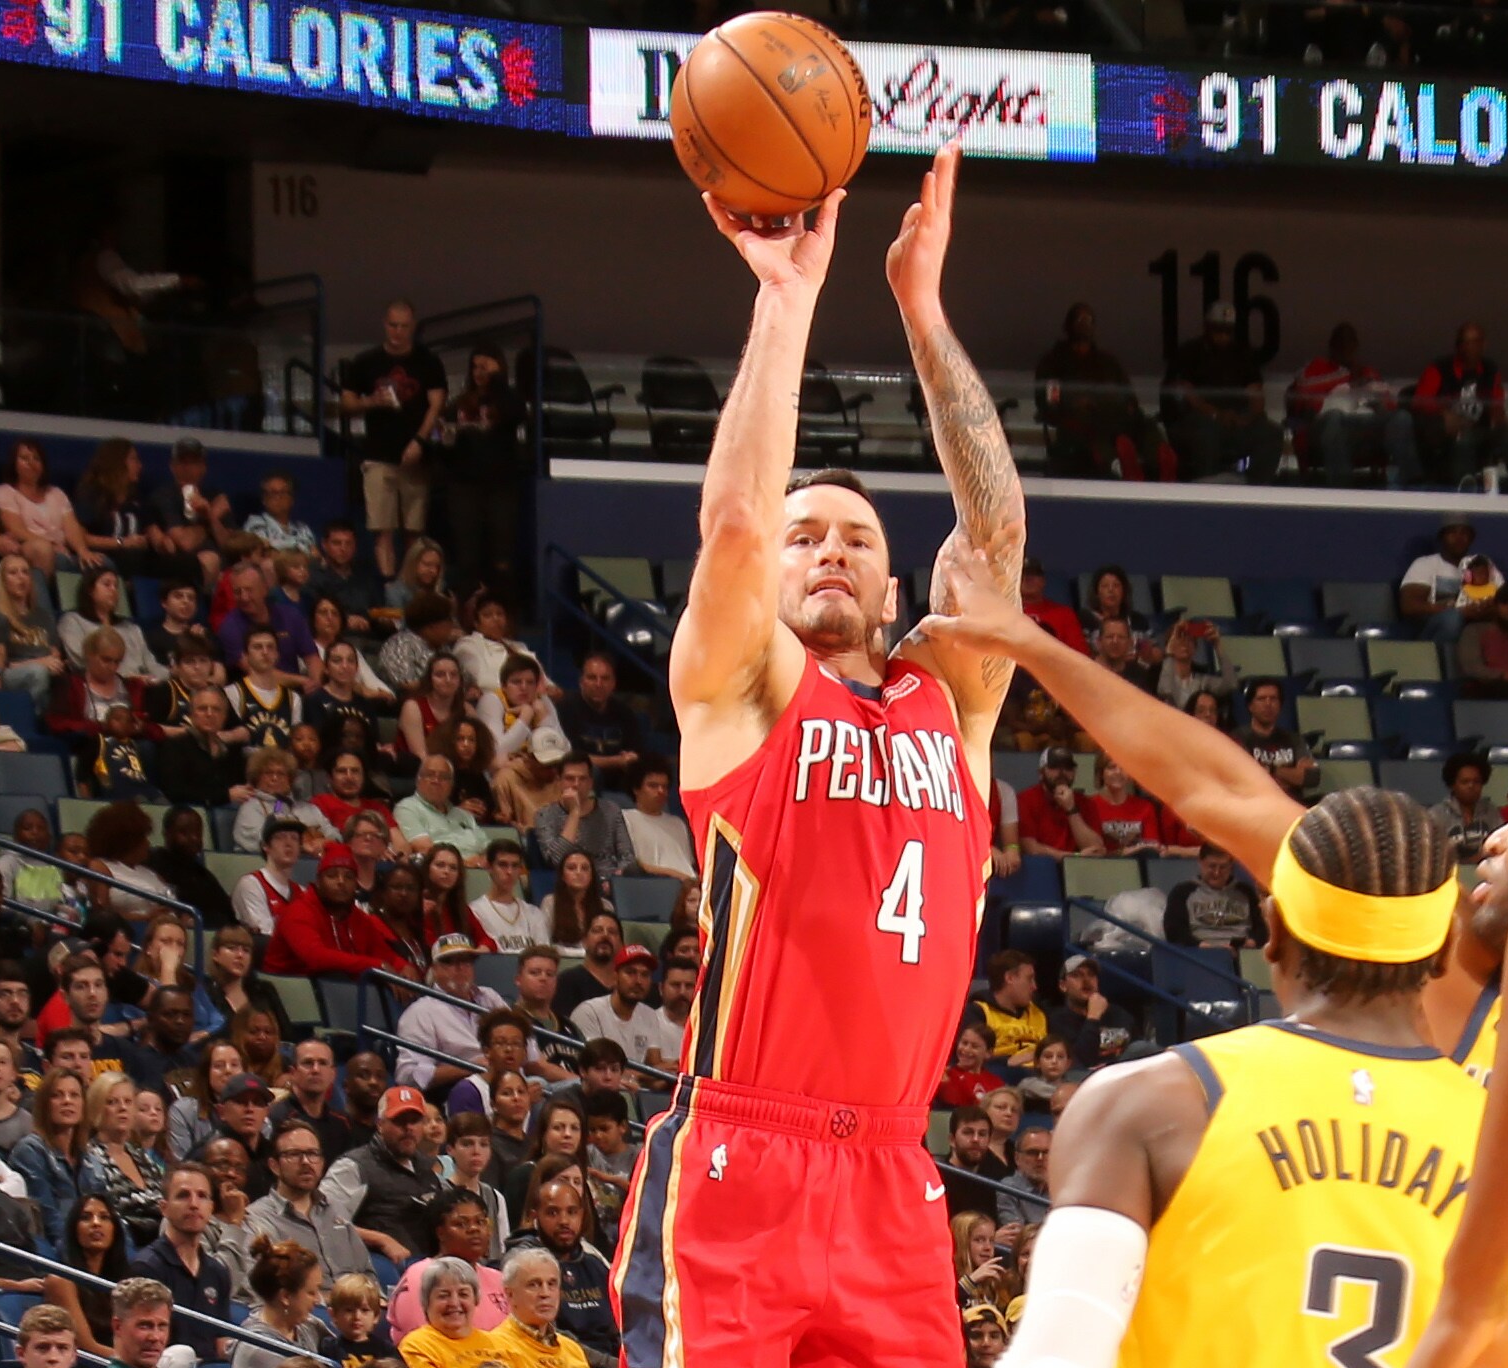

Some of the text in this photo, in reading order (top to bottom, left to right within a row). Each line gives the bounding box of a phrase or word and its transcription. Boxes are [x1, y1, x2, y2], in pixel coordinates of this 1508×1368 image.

[43, 0, 499, 110] 91 CALORIES
[1198, 71, 1277, 155] 91
[268, 174, 319, 218] 116
[795, 717, 965, 824] PELICANS
[876, 839, 926, 965] 4
[1257, 1118, 1470, 1218] HOLIDAY
